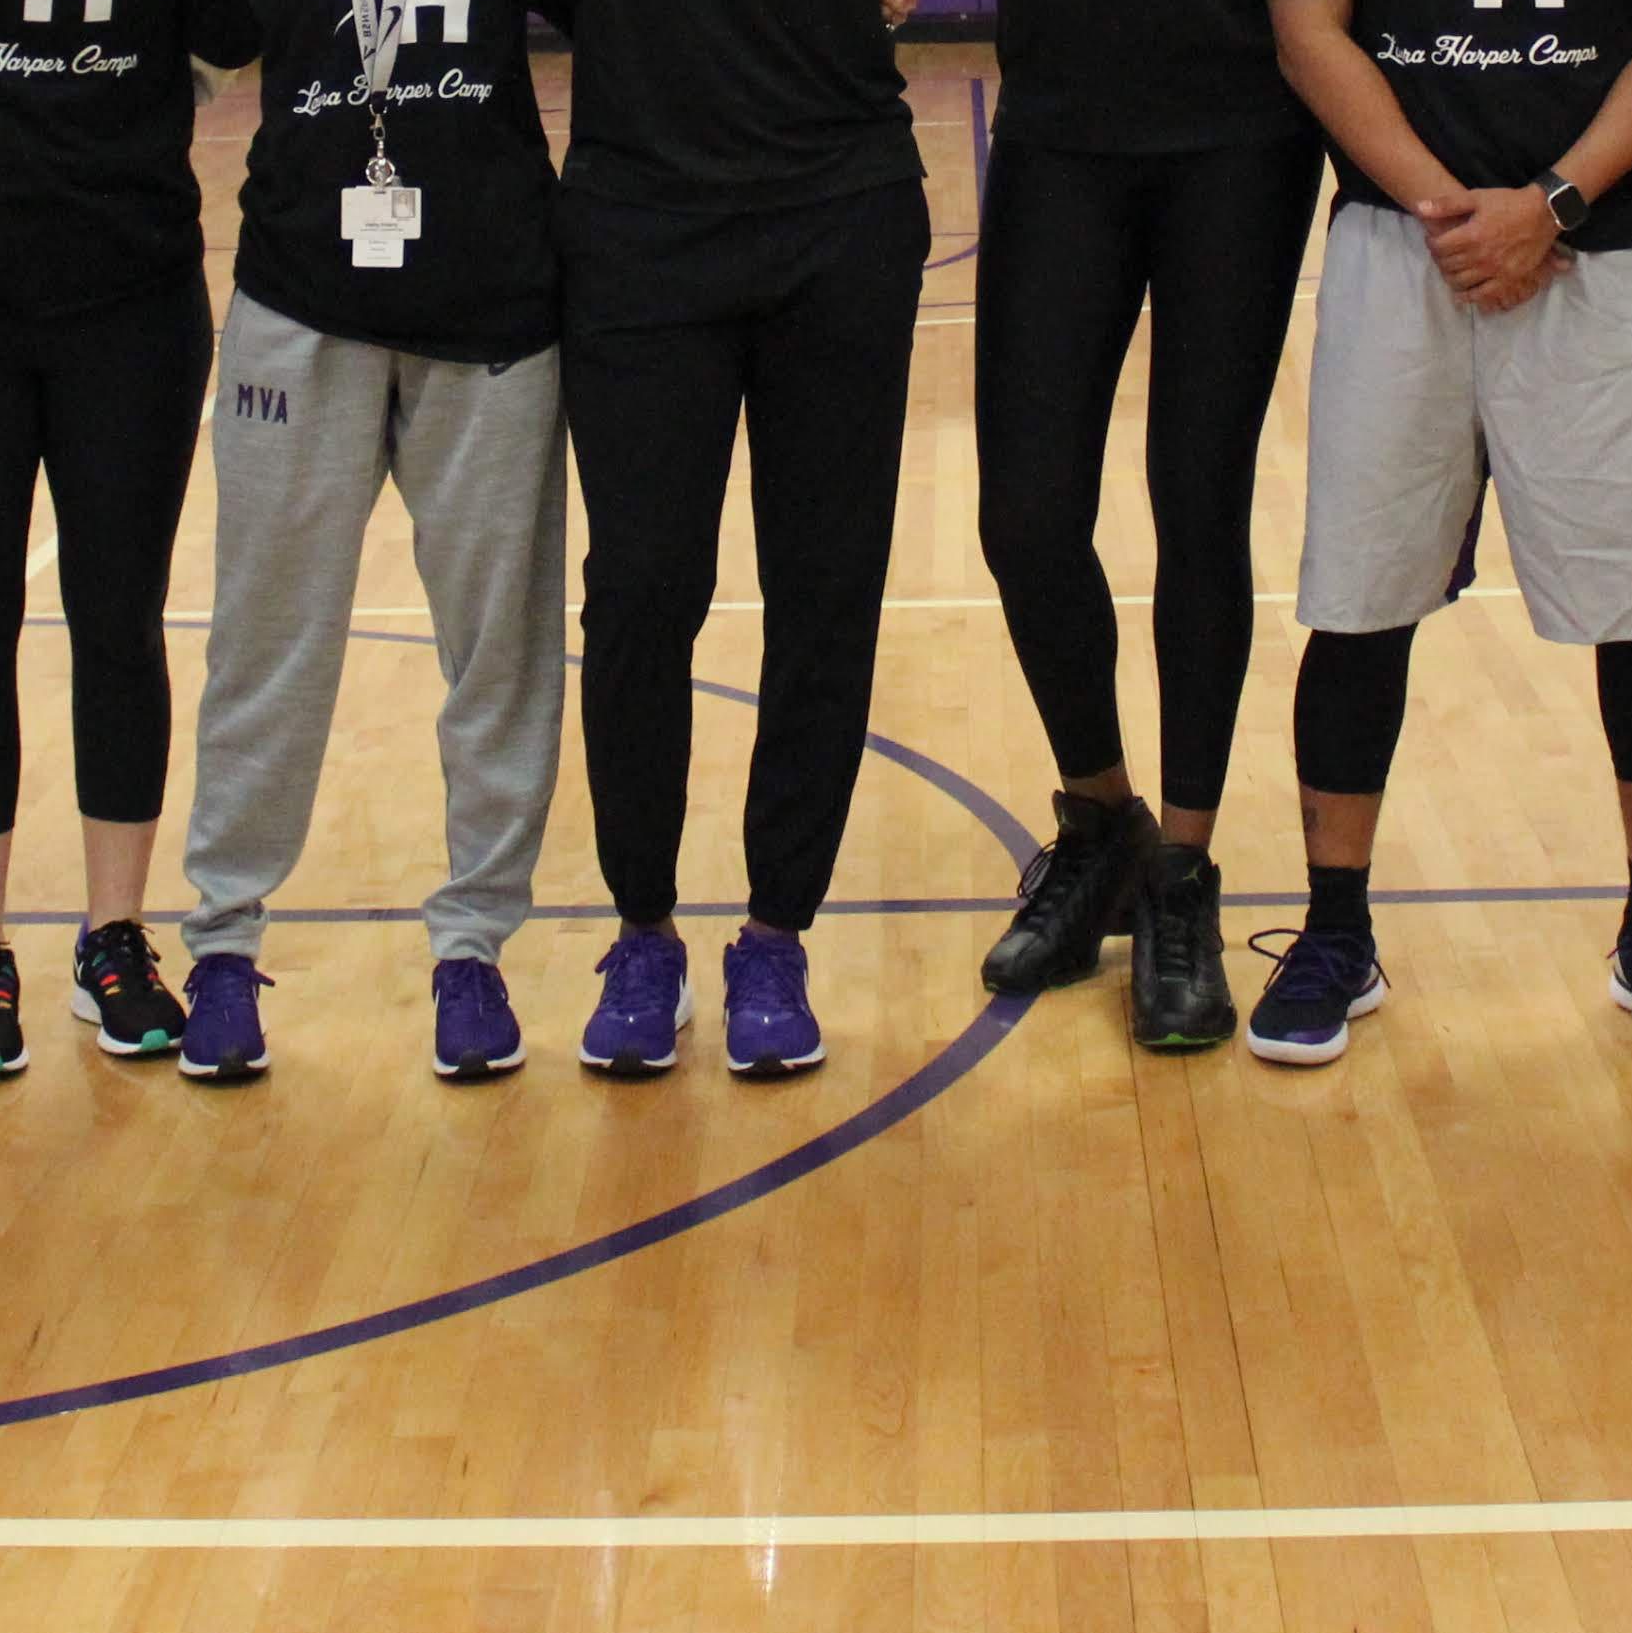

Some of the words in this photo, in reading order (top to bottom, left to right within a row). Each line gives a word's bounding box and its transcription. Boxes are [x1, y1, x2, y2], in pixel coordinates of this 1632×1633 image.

[1431, 34, 1523, 71] Harper
[1529, 34, 1599, 68] Camps
[236, 382, 288, 425] MVA
